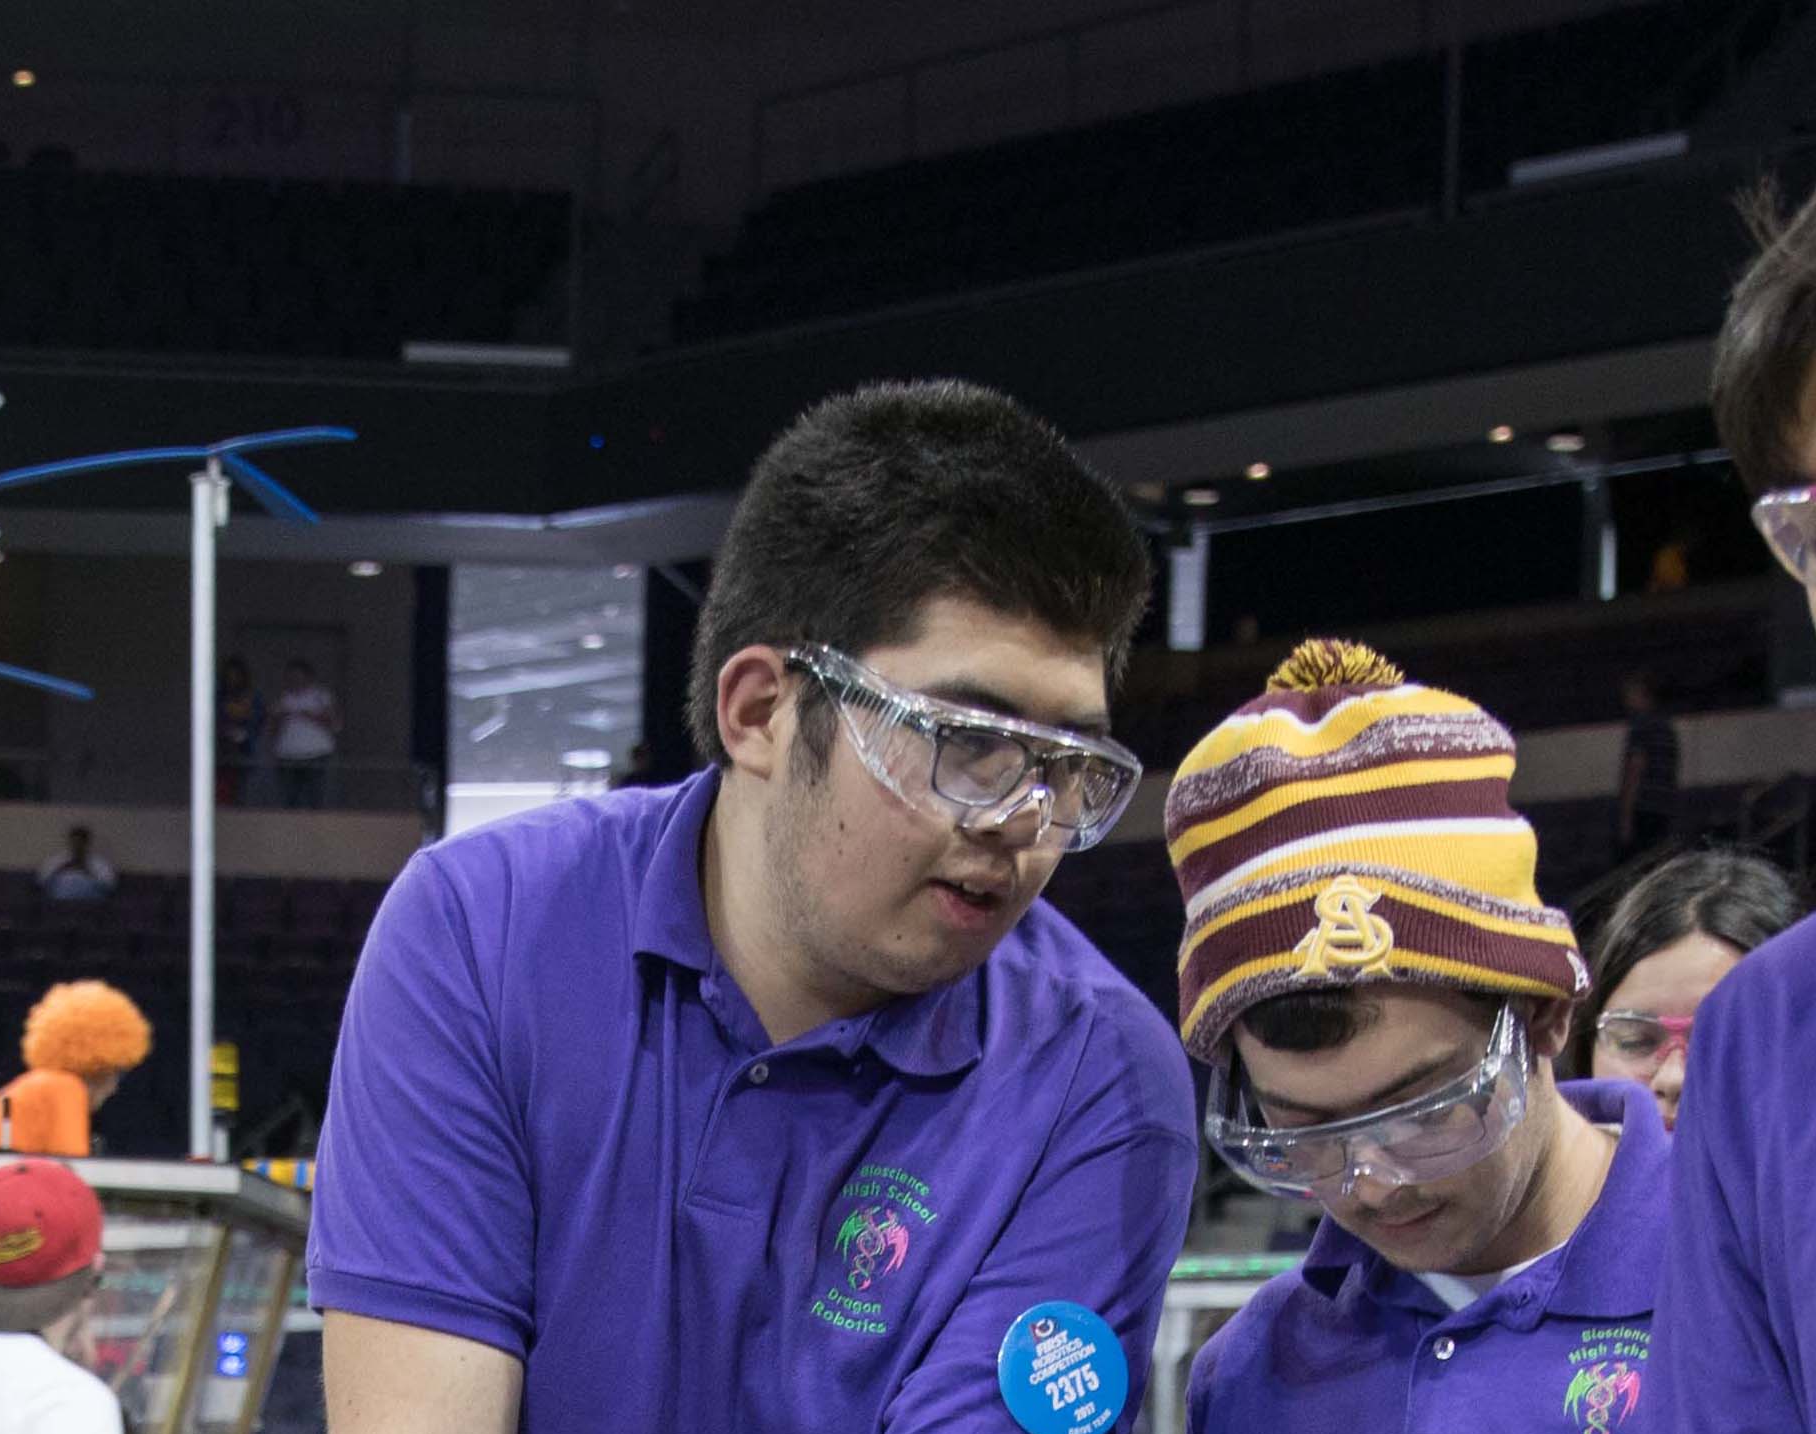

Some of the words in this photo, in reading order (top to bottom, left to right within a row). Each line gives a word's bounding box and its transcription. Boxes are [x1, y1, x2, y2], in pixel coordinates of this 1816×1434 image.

[887, 1185, 937, 1225] School
[811, 1301, 887, 1335] Robotics
[828, 1287, 882, 1315] Dragon
[1568, 1343, 1607, 1364] High
[1614, 1342, 1649, 1360] Scho
[1045, 1362, 1100, 1411] 2375
